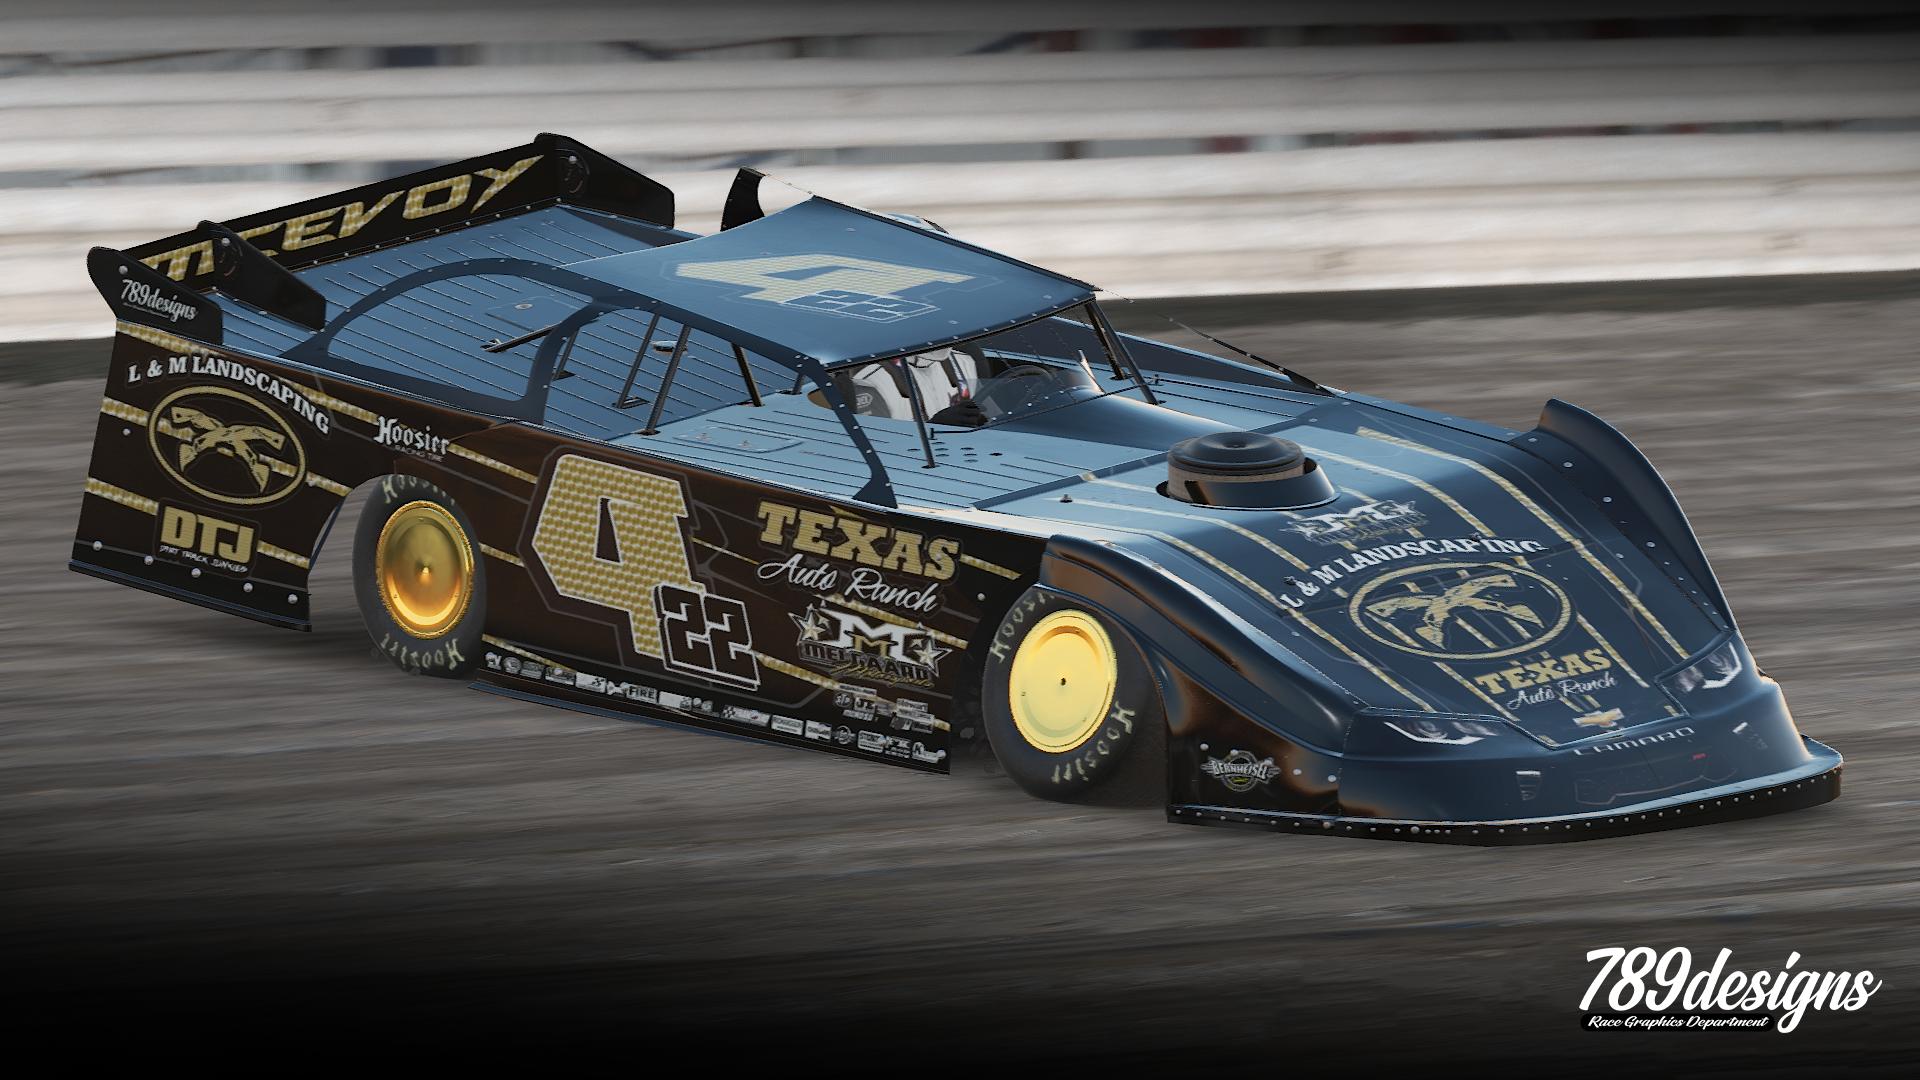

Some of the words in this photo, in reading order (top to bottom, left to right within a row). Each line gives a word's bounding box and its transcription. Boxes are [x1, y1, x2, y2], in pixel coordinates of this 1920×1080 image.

[120, 279, 199, 323] 789designs
[676, 253, 977, 303] 4
[128, 364, 141, 383] L
[147, 359, 163, 378] &
[168, 356, 188, 375] M
[192, 356, 330, 435] LANDSCAPING
[373, 415, 450, 455] Hoosier
[160, 505, 254, 564] DTJ
[532, 454, 705, 660] 4
[757, 501, 960, 581] TEXAS
[757, 553, 839, 590] Auto
[844, 567, 939, 613] Ranch
[1279, 593, 1304, 609] L
[1296, 579, 1321, 597] &
[1311, 564, 1343, 585] M
[1334, 538, 1550, 573] LANDSCAPING
[653, 583, 760, 691] 22
[1474, 648, 1612, 695] TEXAS
[1506, 685, 1554, 710] Auto
[1557, 670, 1617, 697] Ranch
